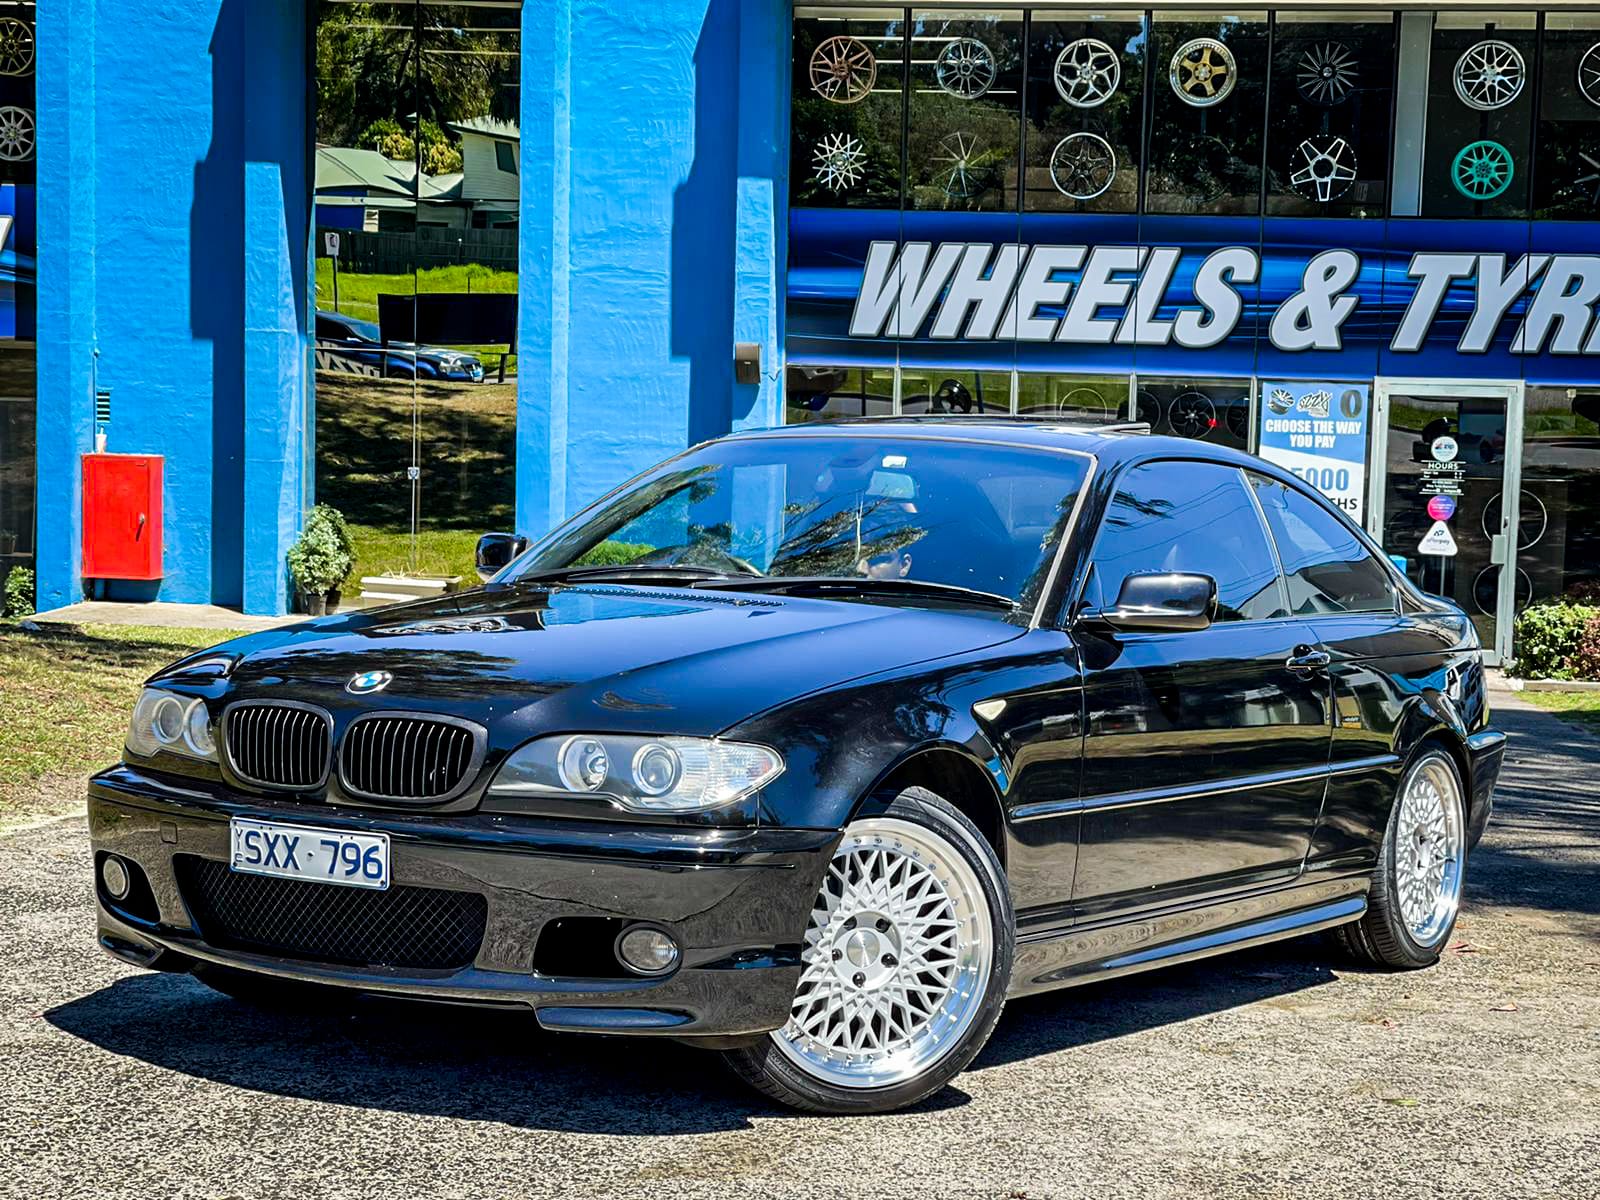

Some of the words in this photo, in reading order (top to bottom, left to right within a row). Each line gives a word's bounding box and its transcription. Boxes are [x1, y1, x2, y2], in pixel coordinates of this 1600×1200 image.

[849, 240, 1260, 349] WHEELS
[1268, 248, 1361, 351] &
[1389, 251, 1600, 355] TYR
[1265, 419, 1312, 433] CHOOSE
[1313, 420, 1335, 434] THE
[1336, 421, 1362, 435] WAY
[1290, 434, 1313, 448] YOU
[1314, 435, 1336, 449] PAY
[1428, 462, 1458, 470] HOURS
[244, 830, 301, 871] SXX
[320, 839, 383, 879] 796
